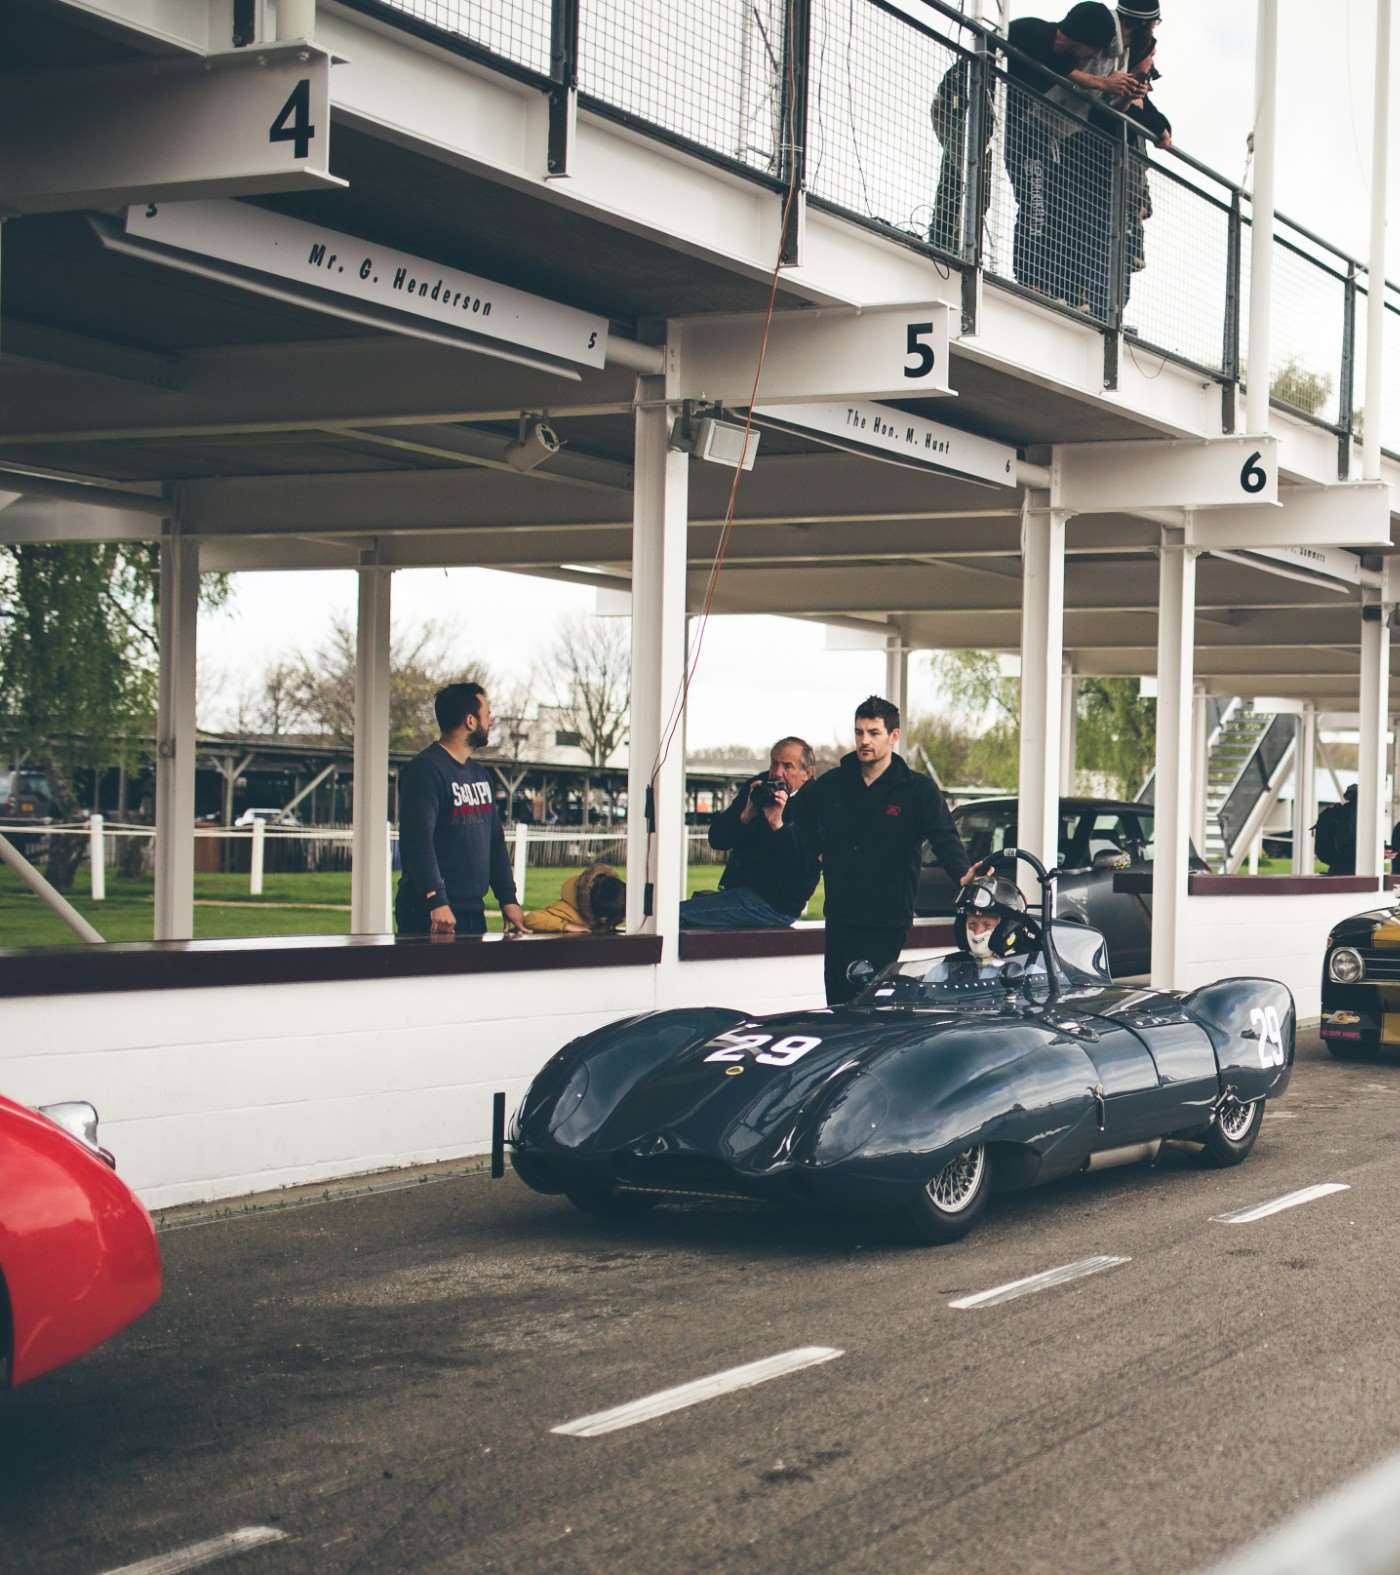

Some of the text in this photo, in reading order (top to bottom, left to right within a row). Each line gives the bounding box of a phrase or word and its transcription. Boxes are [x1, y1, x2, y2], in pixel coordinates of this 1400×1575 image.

[269, 78, 315, 159] 4
[308, 243, 492, 317] Mr. G. Henderson
[588, 331, 598, 350] 5
[903, 322, 935, 379] 5
[846, 408, 951, 455] The Hon. M. Hunt
[1005, 459, 1012, 473] 6
[1240, 451, 1267, 494] 6
[703, 1031, 822, 1067] 29
[1249, 1006, 1285, 1069] 29
